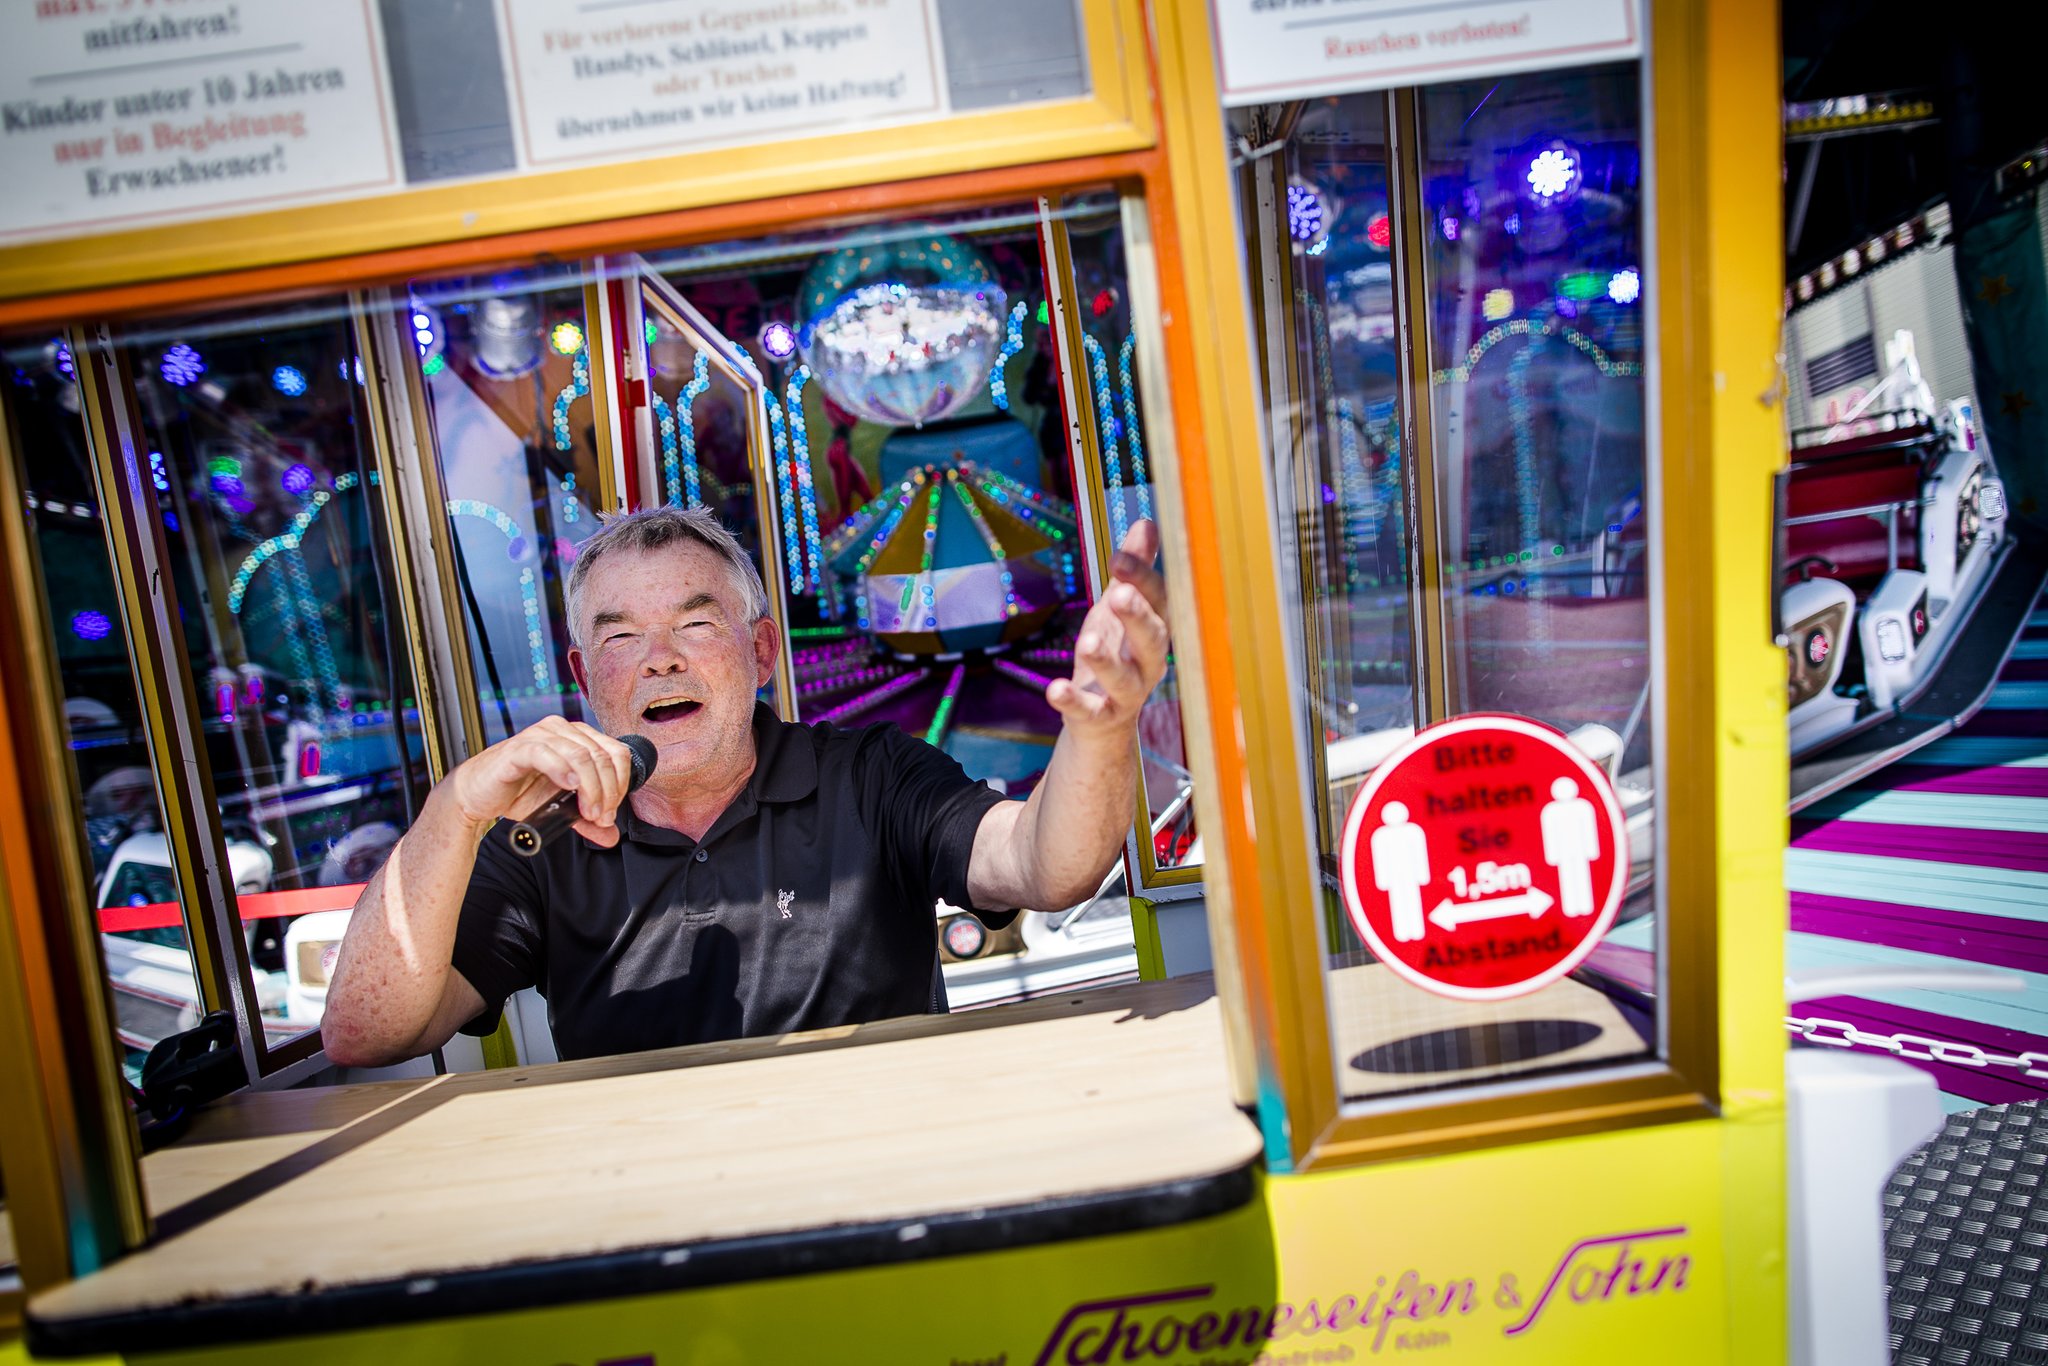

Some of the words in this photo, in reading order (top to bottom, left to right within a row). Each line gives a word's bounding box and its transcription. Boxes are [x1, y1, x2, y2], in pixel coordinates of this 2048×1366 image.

[84, 5, 241, 51] mitfahren!
[543, 28, 585, 53] Für
[1324, 33, 1421, 58] Rauchen
[1427, 14, 1531, 46] verboten!
[573, 46, 665, 80] Handys,
[668, 32, 775, 65] Schlüssel,
[781, 23, 868, 51] Kappen
[2, 97, 106, 134] Kinder
[114, 87, 191, 118] unter
[202, 79, 236, 106] 10
[243, 66, 345, 101] Jahren
[652, 71, 702, 97] oder
[710, 61, 797, 90] Taschen
[557, 99, 695, 140] übernehmen
[701, 95, 737, 119] wir
[743, 88, 801, 115] keine
[808, 72, 907, 108] Haftung!
[54, 136, 108, 163] nur
[112, 126, 144, 154] in
[150, 109, 309, 152] Begleitung
[84, 146, 288, 197] Erwachsener!
[1434, 740, 1517, 772] Bitte
[1426, 783, 1535, 817] halten
[1459, 825, 1511, 853] Sie
[1447, 860, 1532, 900] 1,5m
[1494, 1272, 1522, 1309] &
[1503, 1227, 1690, 1337] Sohn
[1030, 1268, 1476, 1366] Schoeneseifen
[1395, 1331, 1450, 1351] Köln
